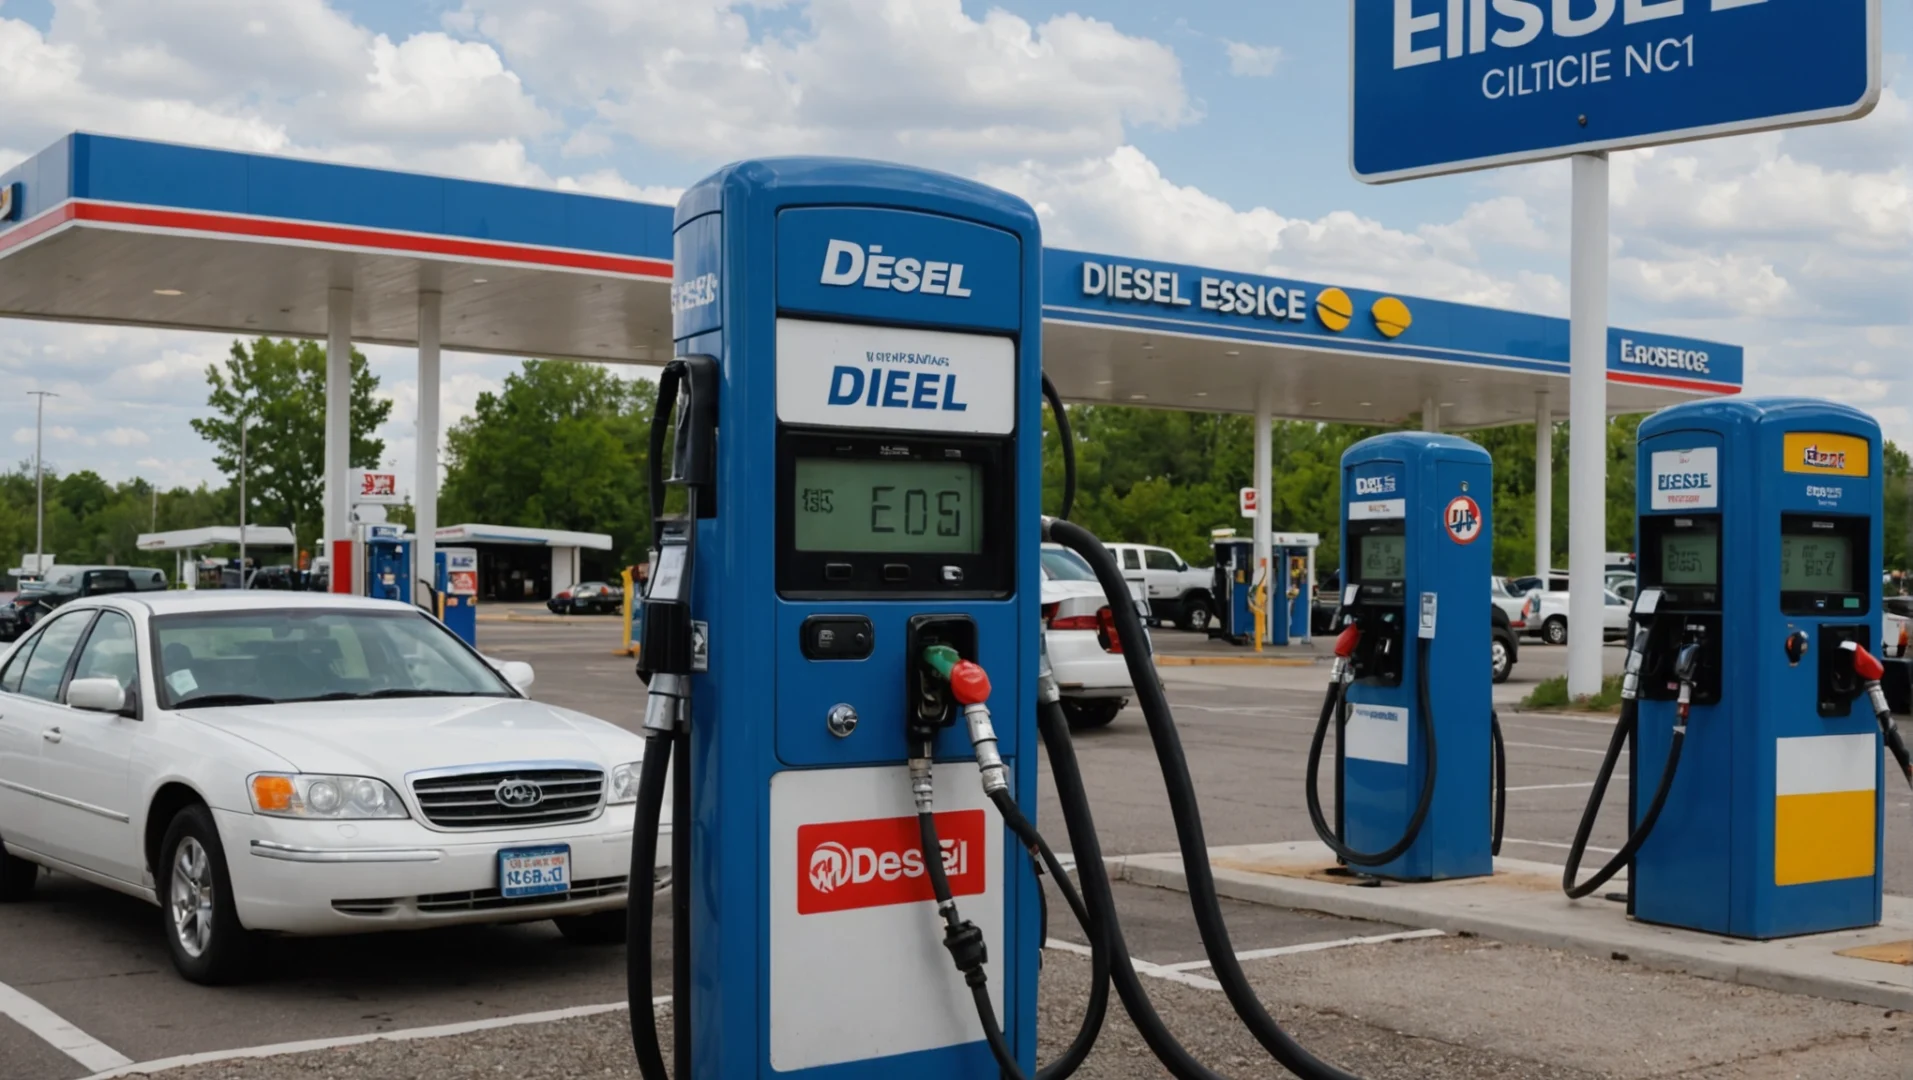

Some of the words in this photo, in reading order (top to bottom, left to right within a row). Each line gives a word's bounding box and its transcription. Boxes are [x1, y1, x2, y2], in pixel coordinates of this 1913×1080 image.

[1481, 49, 1612, 100] CILTICIE
[1082, 261, 1192, 306] DIESEL
[1200, 276, 1307, 320] ESSICE
[827, 366, 967, 411] DIEEL
